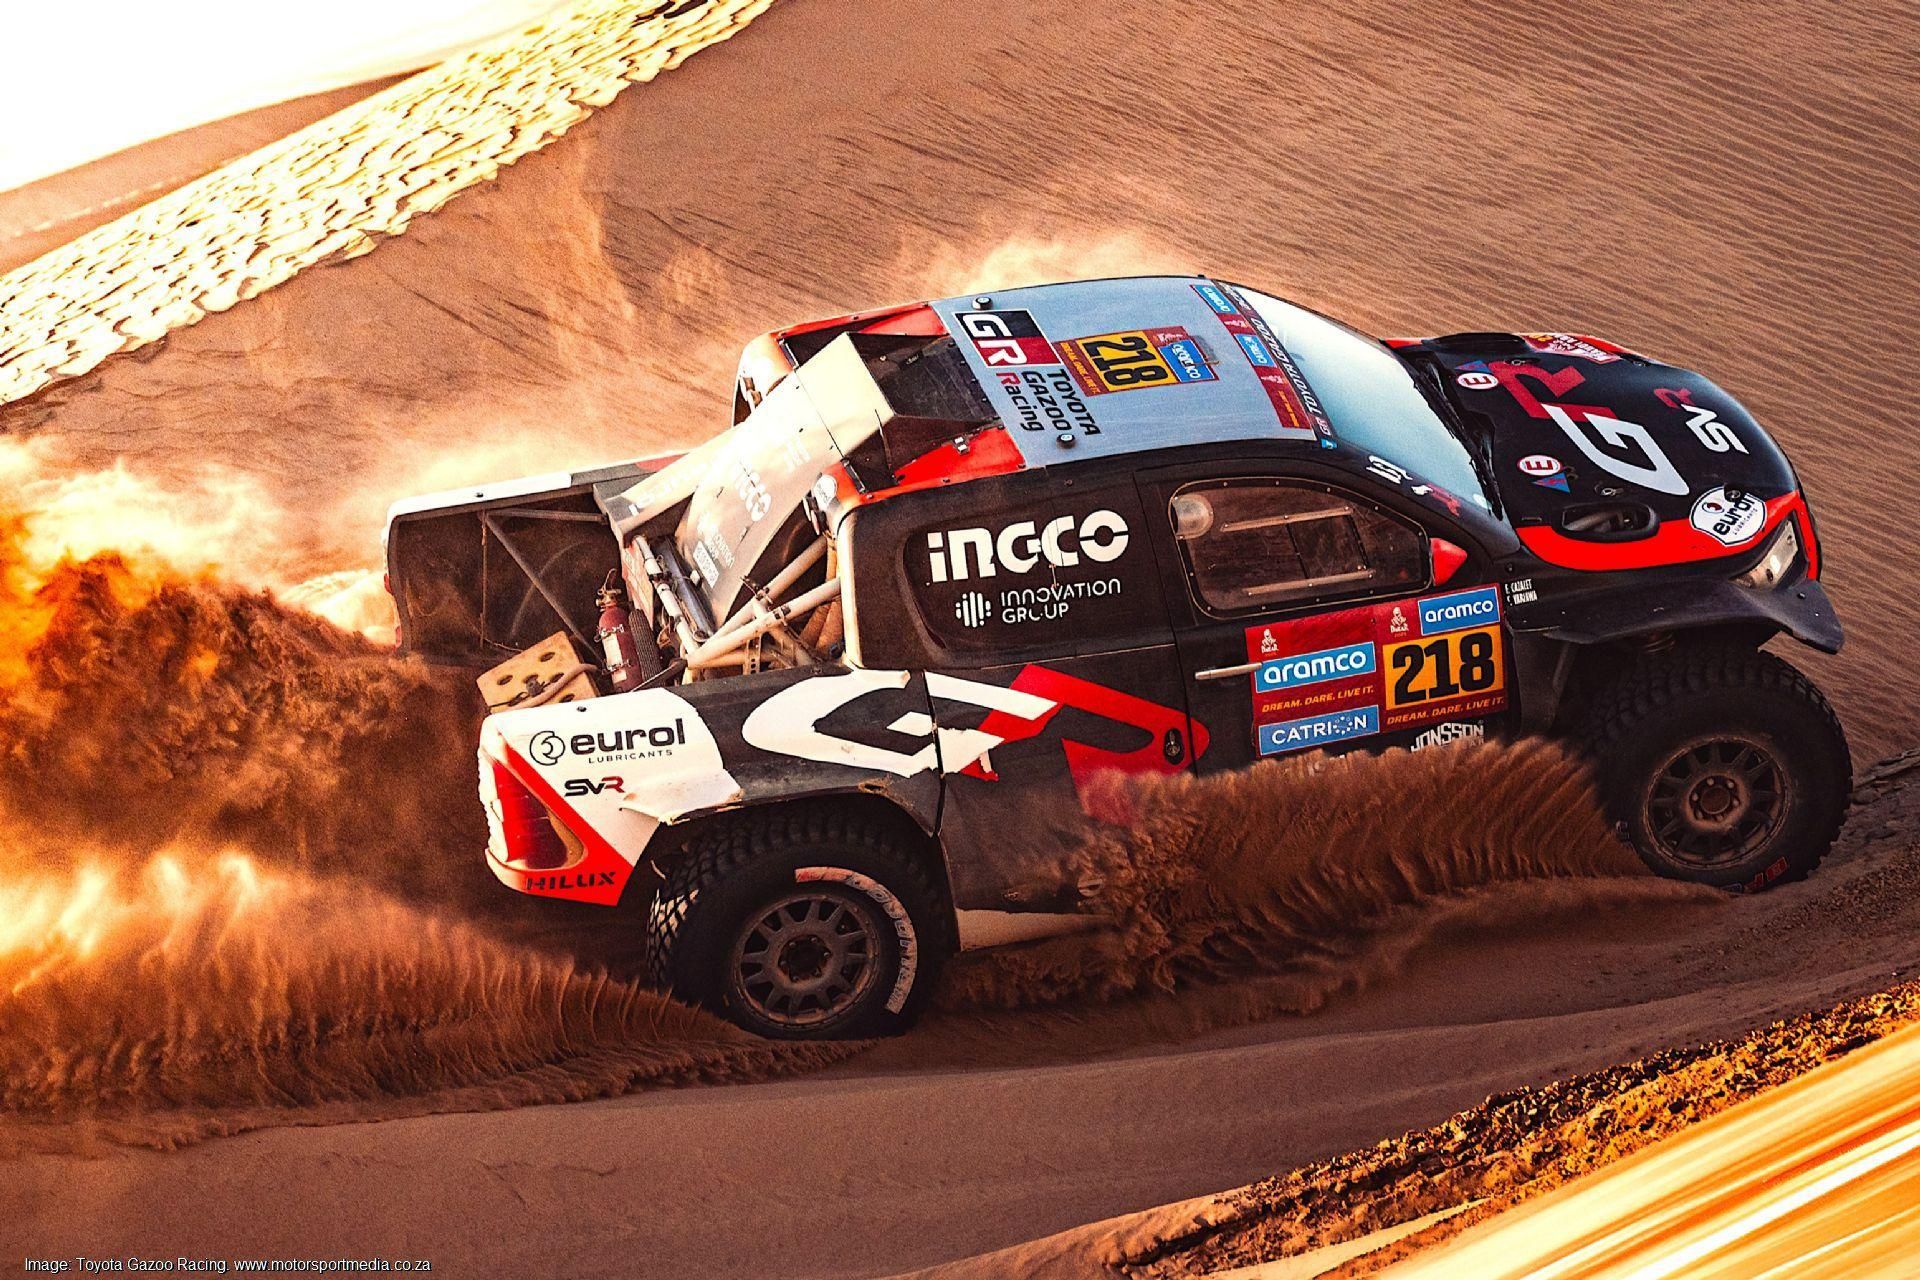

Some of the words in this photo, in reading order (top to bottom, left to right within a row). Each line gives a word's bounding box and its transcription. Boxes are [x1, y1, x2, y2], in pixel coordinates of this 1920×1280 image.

[962, 313, 1028, 365] GR
[1082, 336, 1169, 386] 218
[1463, 375, 1492, 386] E
[996, 372, 1045, 432] Racing
[1021, 370, 1072, 431] GAZOO
[1047, 368, 1102, 436] TOYOTA
[1488, 361, 1690, 495] GR
[1653, 388, 1750, 454] SVR
[1525, 459, 1554, 471] E
[1713, 496, 1756, 536] eurol
[1001, 578, 1121, 606] INNOVATION
[1425, 600, 1494, 622] aramco
[1263, 650, 1367, 684] aramco
[1392, 632, 1496, 706] 218
[1262, 699, 1302, 713] DREAM.
[1304, 692, 1336, 706] DARE.
[1337, 687, 1360, 699] LIVE
[1362, 685, 1374, 695] IT.
[1387, 711, 1430, 725] DREAM.
[1431, 704, 1464, 717] DARE.
[1466, 698, 1491, 710] LIVE
[1491, 696, 1505, 707] IT.
[570, 718, 686, 756] eurol
[1410, 722, 1484, 753] JONSSON
[588, 749, 673, 764] LUBRICANTS
[564, 776, 625, 797] SVR
[527, 871, 616, 891] HILUX
